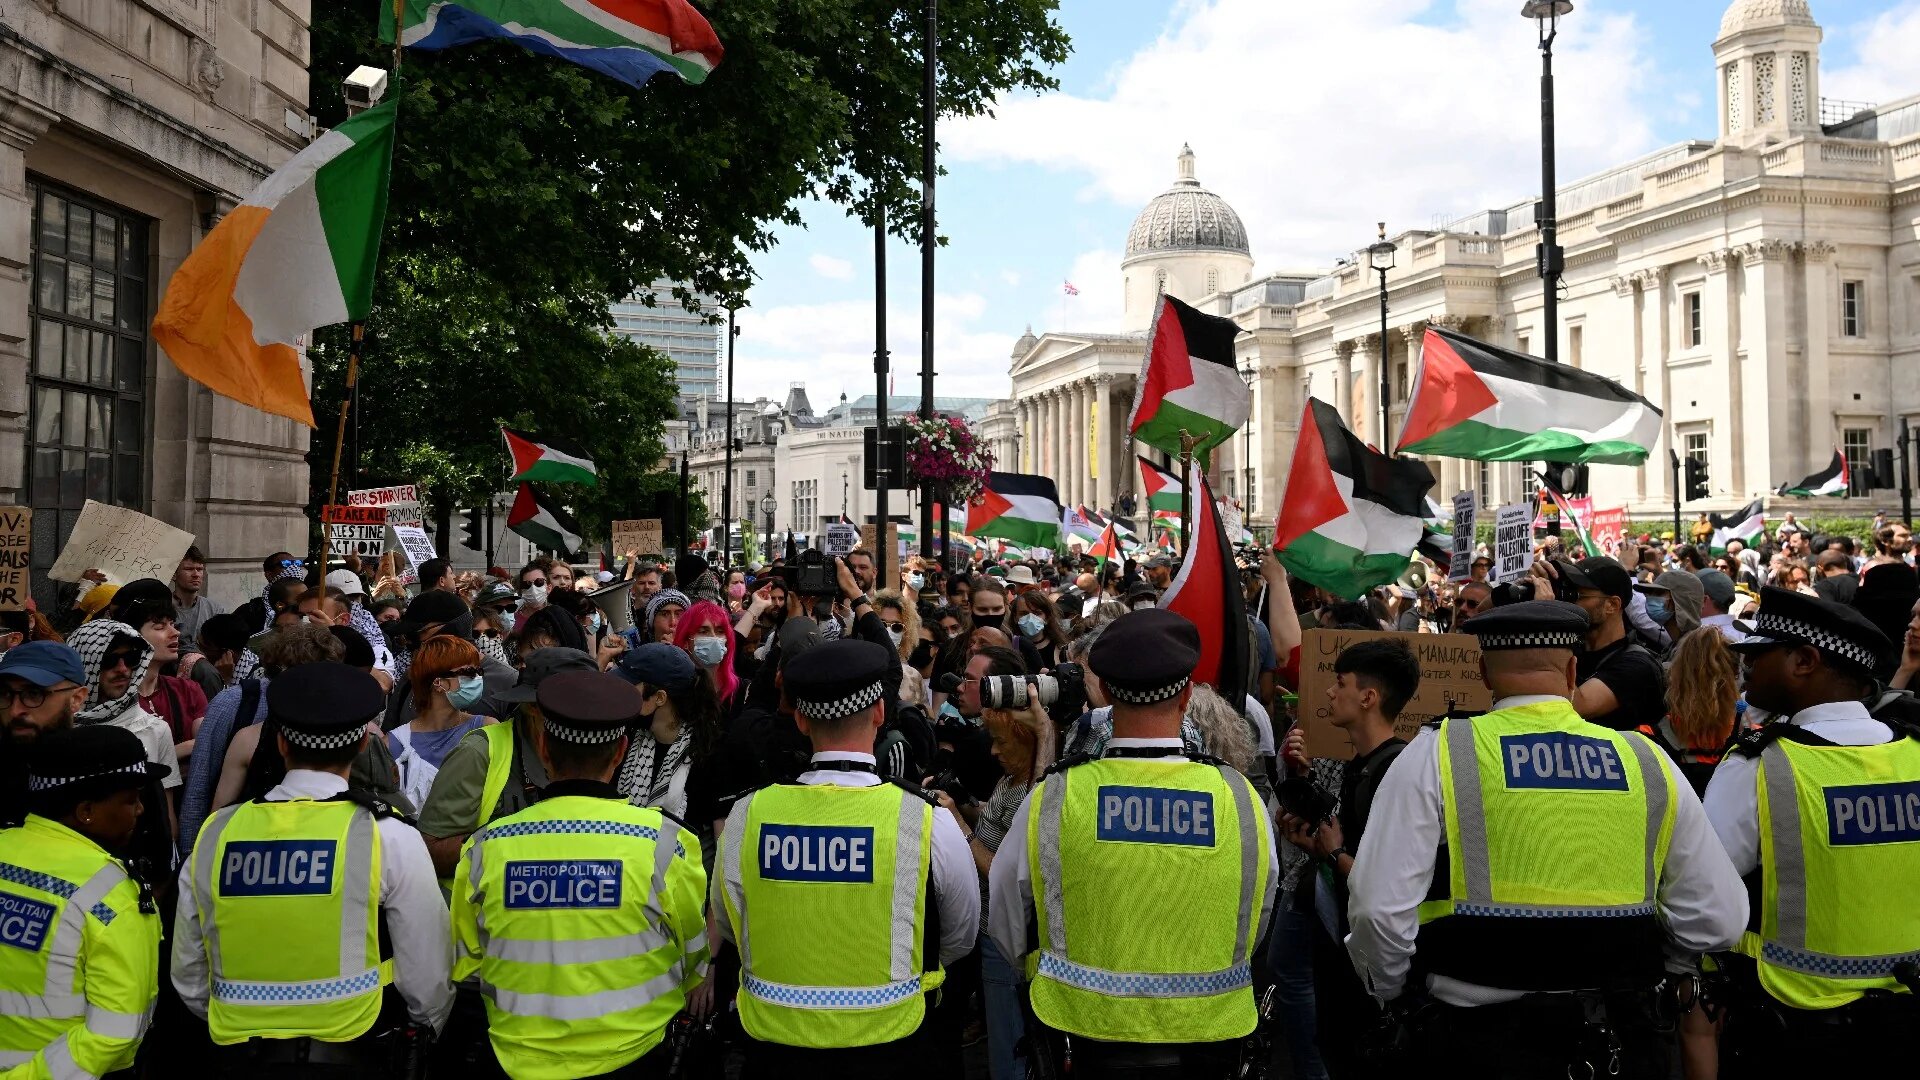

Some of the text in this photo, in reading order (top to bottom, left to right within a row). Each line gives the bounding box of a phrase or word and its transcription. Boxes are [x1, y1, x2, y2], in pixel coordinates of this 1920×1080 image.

[348, 486, 416, 506] KEIR STARVER
[345, 507, 364, 521] ARE
[367, 507, 386, 521] ALL
[386, 506, 421, 522] ARMING
[622, 521, 654, 532] STAND
[1498, 523, 1529, 543] HANDS OFF
[0, 534, 27, 547] SEE
[1498, 538, 1530, 558] PALESTINE
[1502, 555, 1524, 573] ACTION
[1509, 742, 1621, 780] POLICE
[1104, 795, 1209, 836] POLICE
[764, 834, 866, 872] POLICE
[225, 849, 329, 886] POLICE
[510, 865, 617, 877] METROPOLITAN
[509, 879, 616, 904] POLICE
